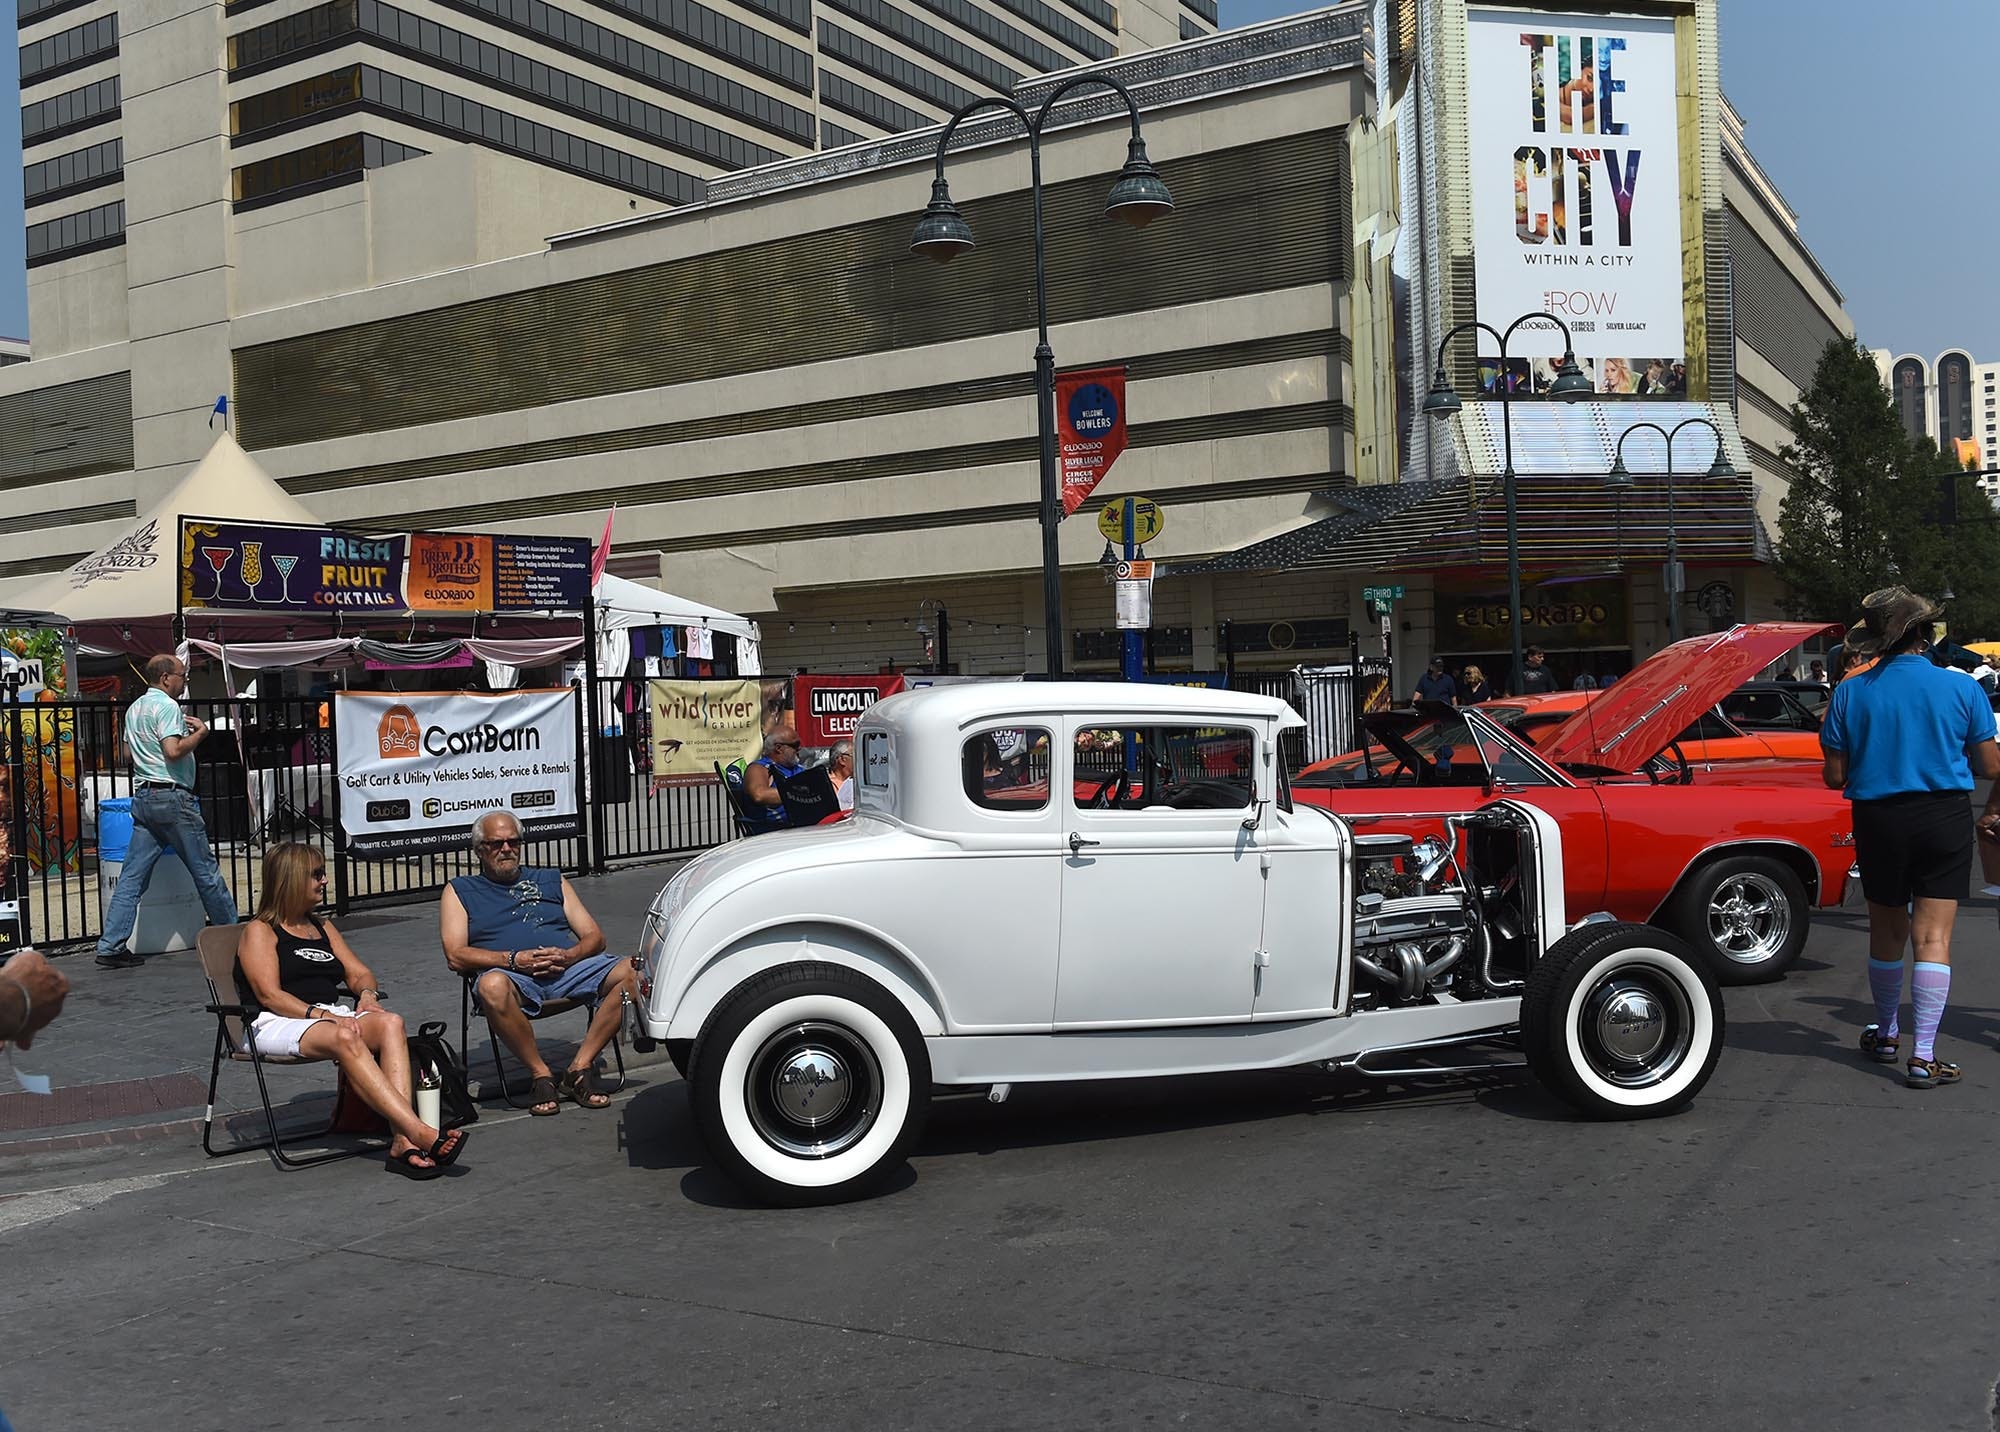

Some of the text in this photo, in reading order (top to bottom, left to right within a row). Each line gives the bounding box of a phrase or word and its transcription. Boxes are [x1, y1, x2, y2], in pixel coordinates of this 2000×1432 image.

[1520, 34, 1629, 135] THE
[1513, 146, 1641, 246] CITY
[1524, 254, 1634, 266] WITHIN A CITY
[1551, 291, 1617, 315] ROW
[1606, 322, 1624, 330] SILVER
[1082, 408, 1104, 418] WELCOME
[1076, 417, 1111, 430] BOWLERS
[1065, 456, 1104, 466] SILVER LEGACY
[320, 536, 391, 561] FRESH
[420, 549, 453, 566] BREW
[321, 565, 387, 588] FRUIT
[428, 559, 481, 579] BROTHERS
[313, 591, 395, 605] COCKTAILS
[1373, 588, 1391, 598] THIRD
[659, 696, 753, 719] wild river
[814, 692, 875, 712] LINCOLN
[712, 721, 751, 729] GRILLE
[423, 723, 540, 757] CartBarn
[346, 761, 571, 789] Golf Cart & Utility Vehicles Sales, Service & Rentals
[371, 805, 407, 817] Club Car
[443, 797, 504, 812] CUSHMAN
